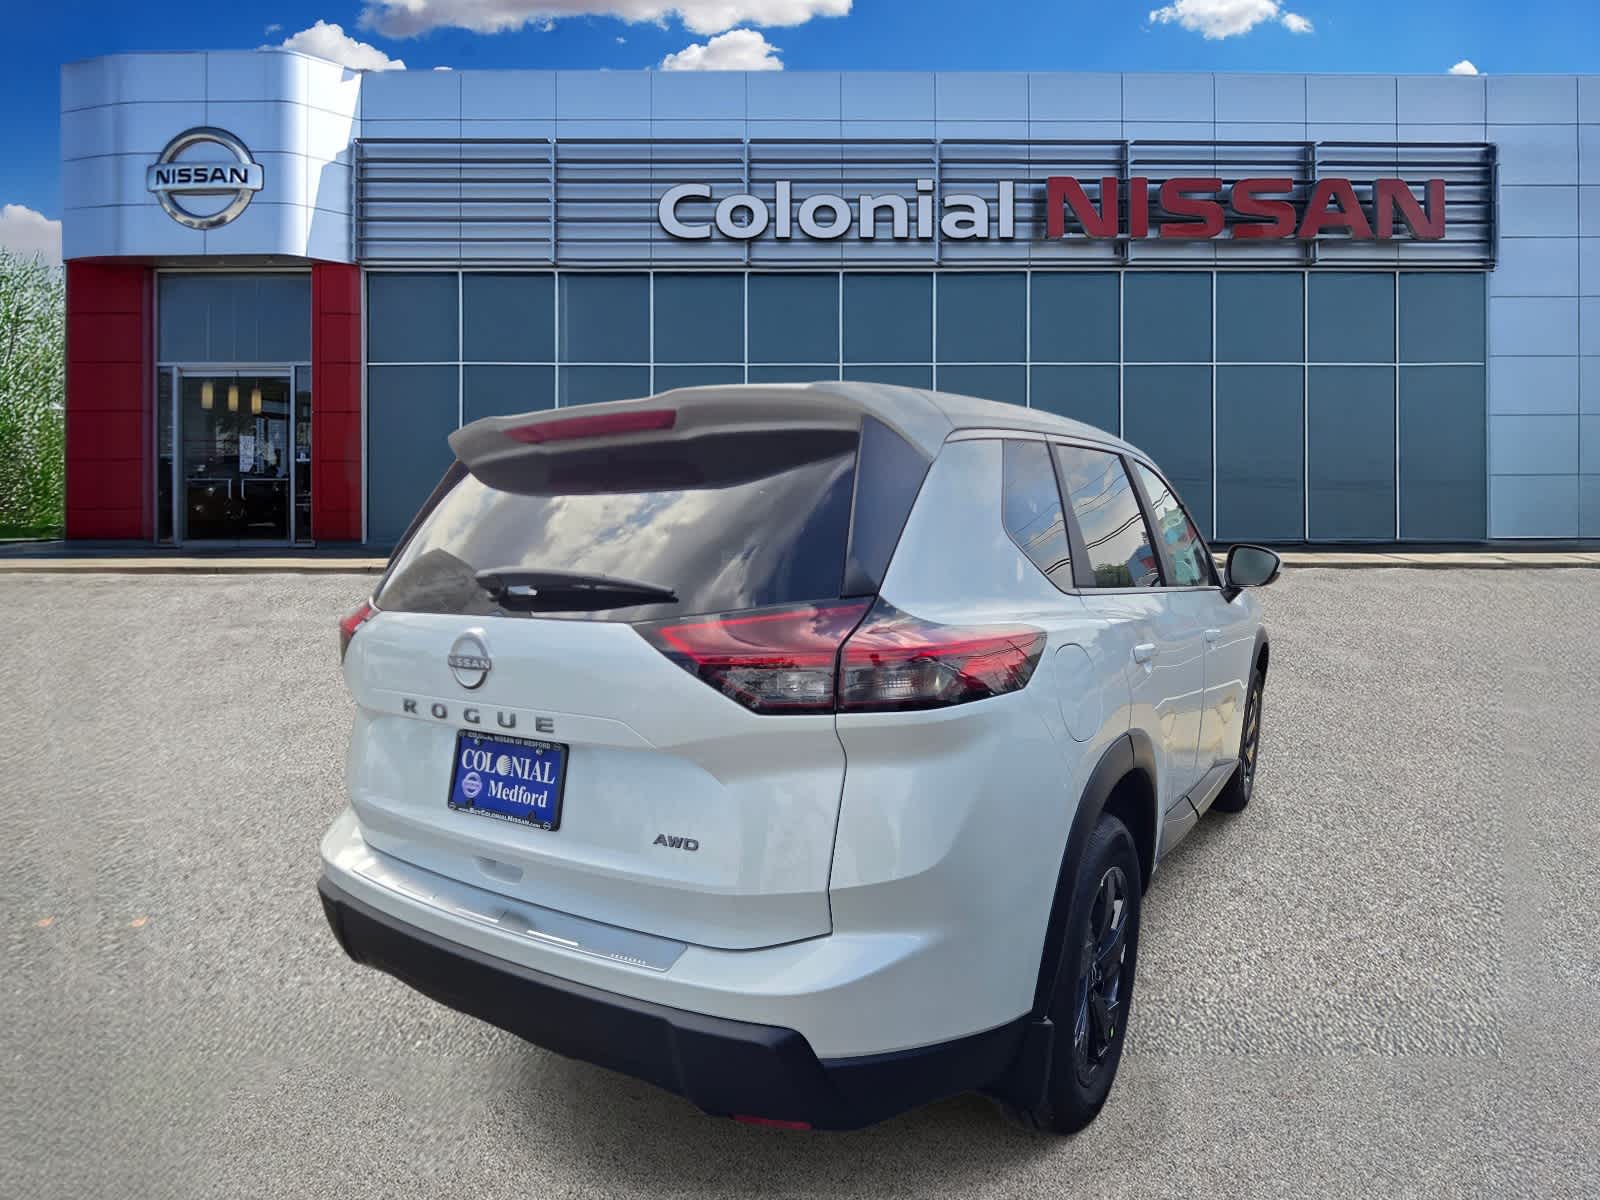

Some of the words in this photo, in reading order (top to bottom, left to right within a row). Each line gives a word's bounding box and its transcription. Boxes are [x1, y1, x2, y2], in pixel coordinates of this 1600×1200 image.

[156, 168, 249, 185] NISSAN
[658, 179, 1014, 239] Colonial
[1045, 176, 1446, 240] NISSAN
[403, 698, 555, 734] ROGUE
[461, 748, 556, 785] COLONIAL
[487, 780, 549, 808] Medford
[653, 833, 699, 851] AWD
